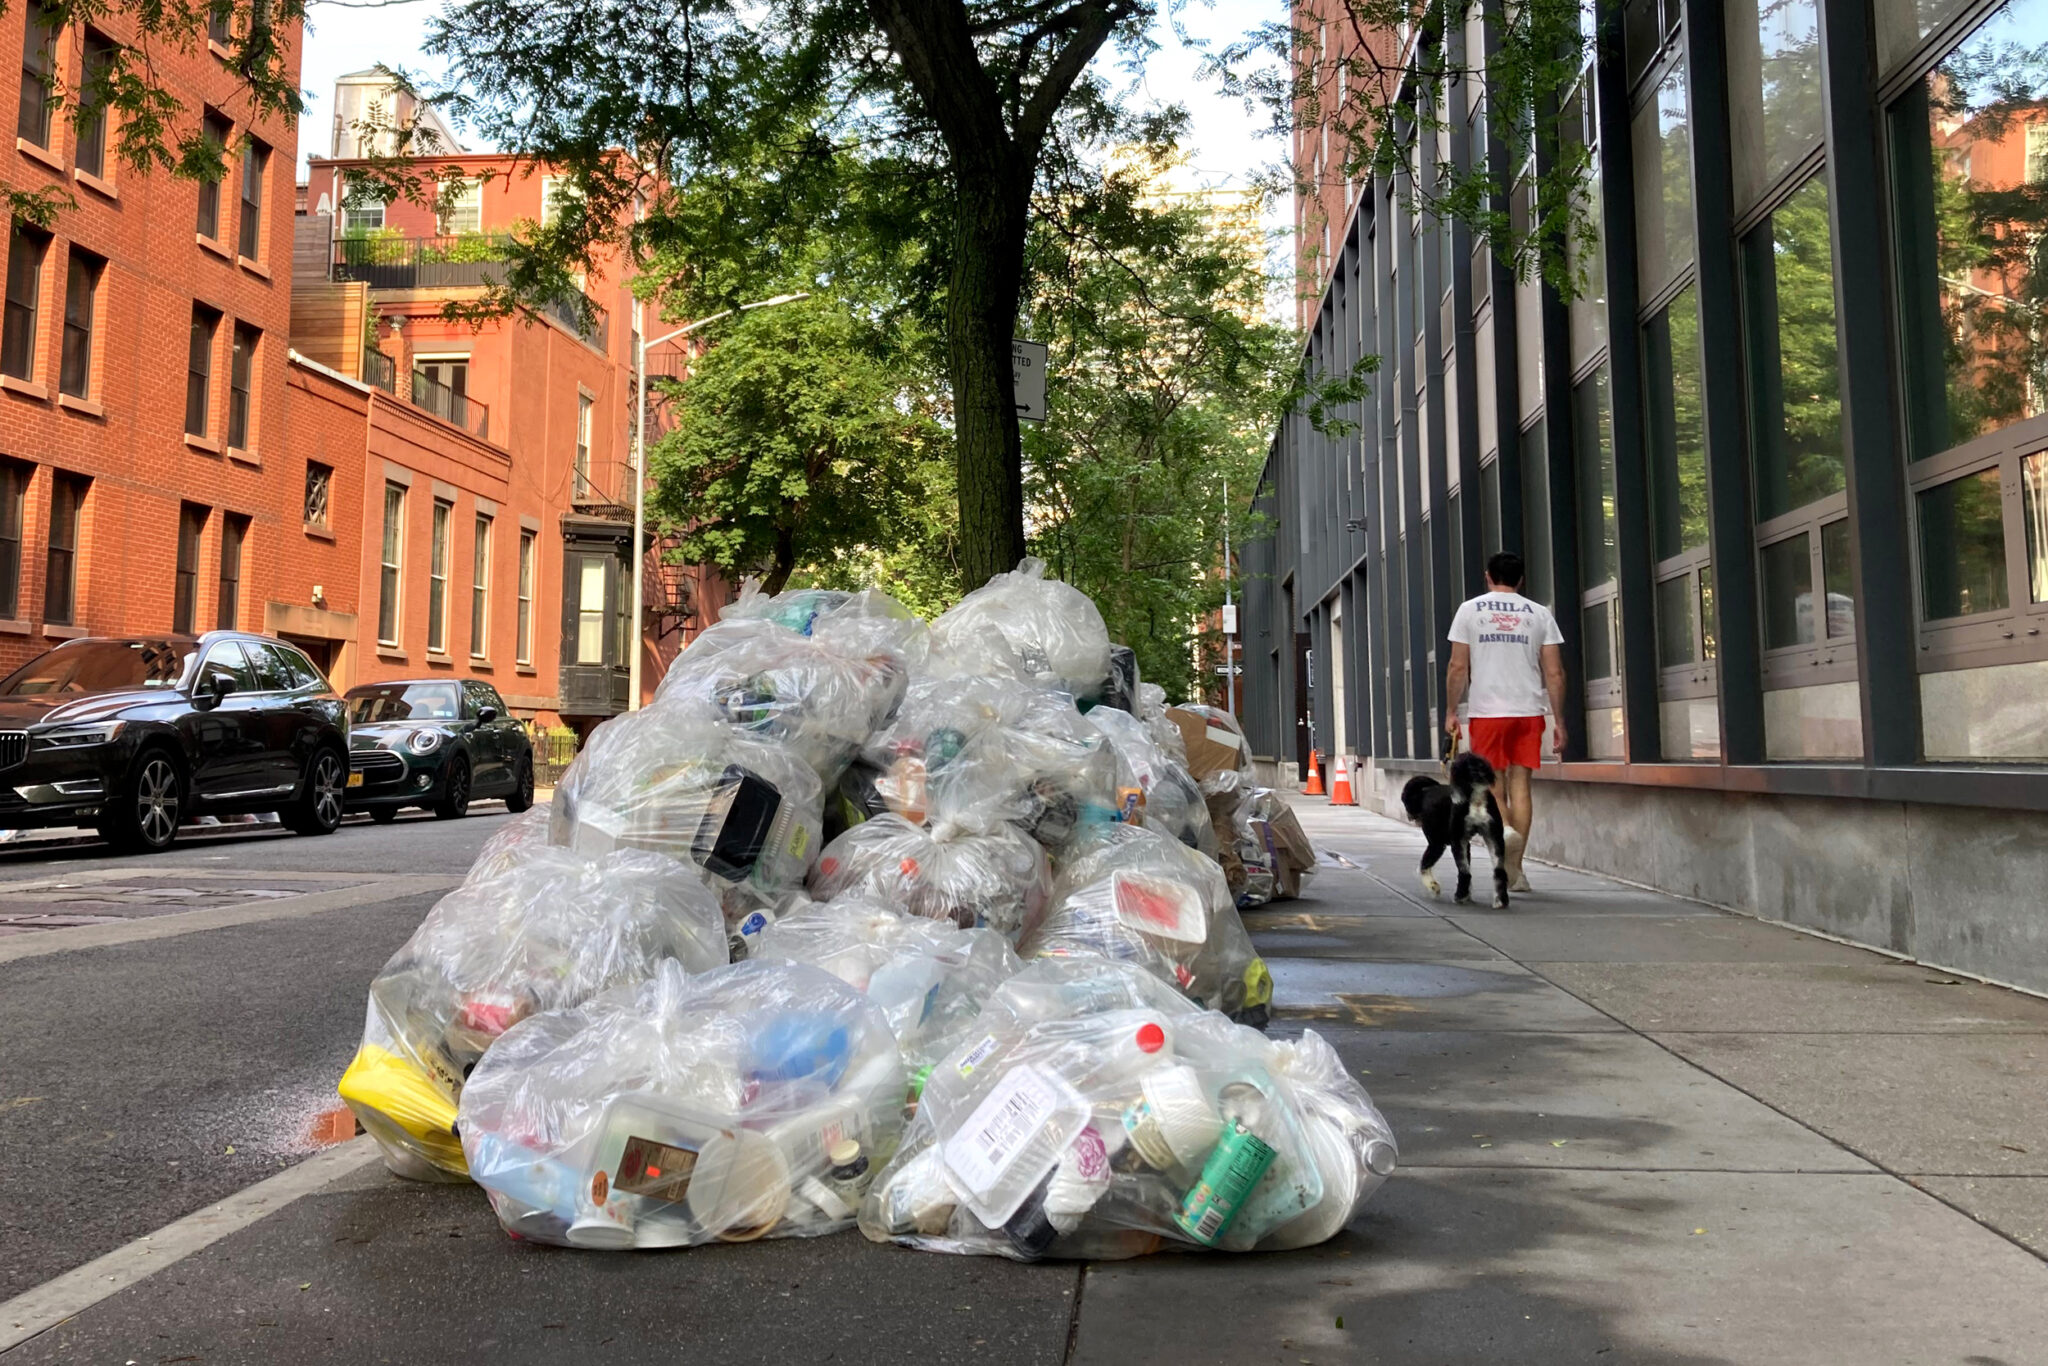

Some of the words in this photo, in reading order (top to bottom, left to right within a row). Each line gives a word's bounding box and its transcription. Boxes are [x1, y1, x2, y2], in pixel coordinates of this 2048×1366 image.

[1012, 355, 1031, 367] TTED
[1476, 601, 1534, 614] PHILA
[1479, 633, 1529, 645] BASKETBALL
